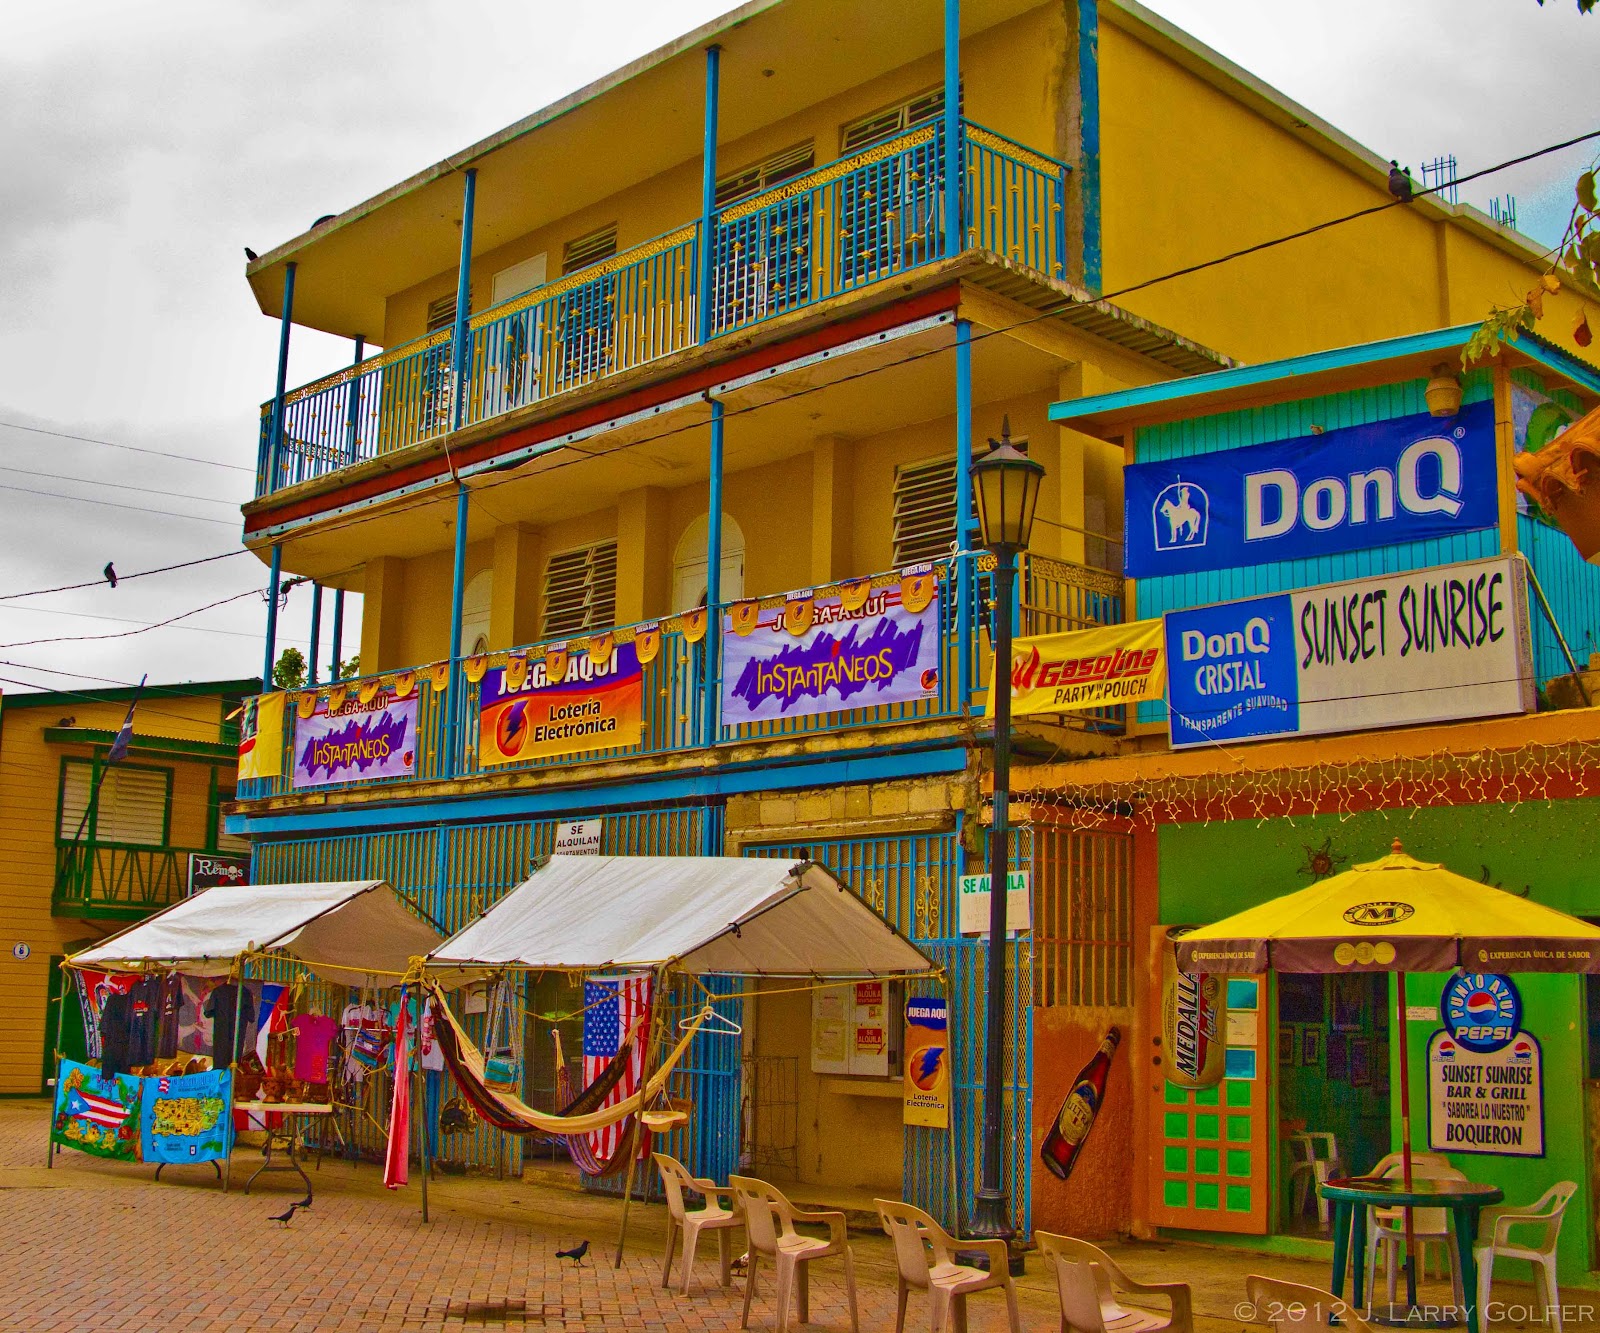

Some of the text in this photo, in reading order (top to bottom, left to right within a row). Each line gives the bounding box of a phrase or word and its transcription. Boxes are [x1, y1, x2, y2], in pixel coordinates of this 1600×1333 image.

[1244, 434, 1464, 543] DonQ
[1301, 573, 1504, 669] SUNSET SUNRISE
[1182, 617, 1270, 661] DonQ
[1195, 660, 1266, 695] CRISTAL
[1054, 685, 1095, 704] PARTY
[1103, 678, 1148, 699] POUCH
[549, 699, 600, 722] Lotería
[1180, 695, 1288, 730] TRANSPARENTE SUAVIDAD
[534, 717, 616, 742] Electrónica
[570, 825, 584, 835] SE
[556, 836, 599, 848] ALQUILAN
[963, 874, 1025, 894] SE ALILA
[1489, 949, 1590, 960] EXPERIENCIA ÚNICA DE SABOR
[1450, 974, 1514, 1019] PUNTO AZUL
[908, 1007, 946, 1020] JUEGA AQU
[1454, 1026, 1513, 1040] PEPSI
[1442, 1065, 1533, 1085] SUNSET SUNRISE
[1447, 1085, 1527, 1100] BAR & GRILL
[906, 1099, 945, 1109] Electrónica
[1480, 1103, 1490, 1120] LO
[1446, 1123, 1522, 1146] BOQUERON
